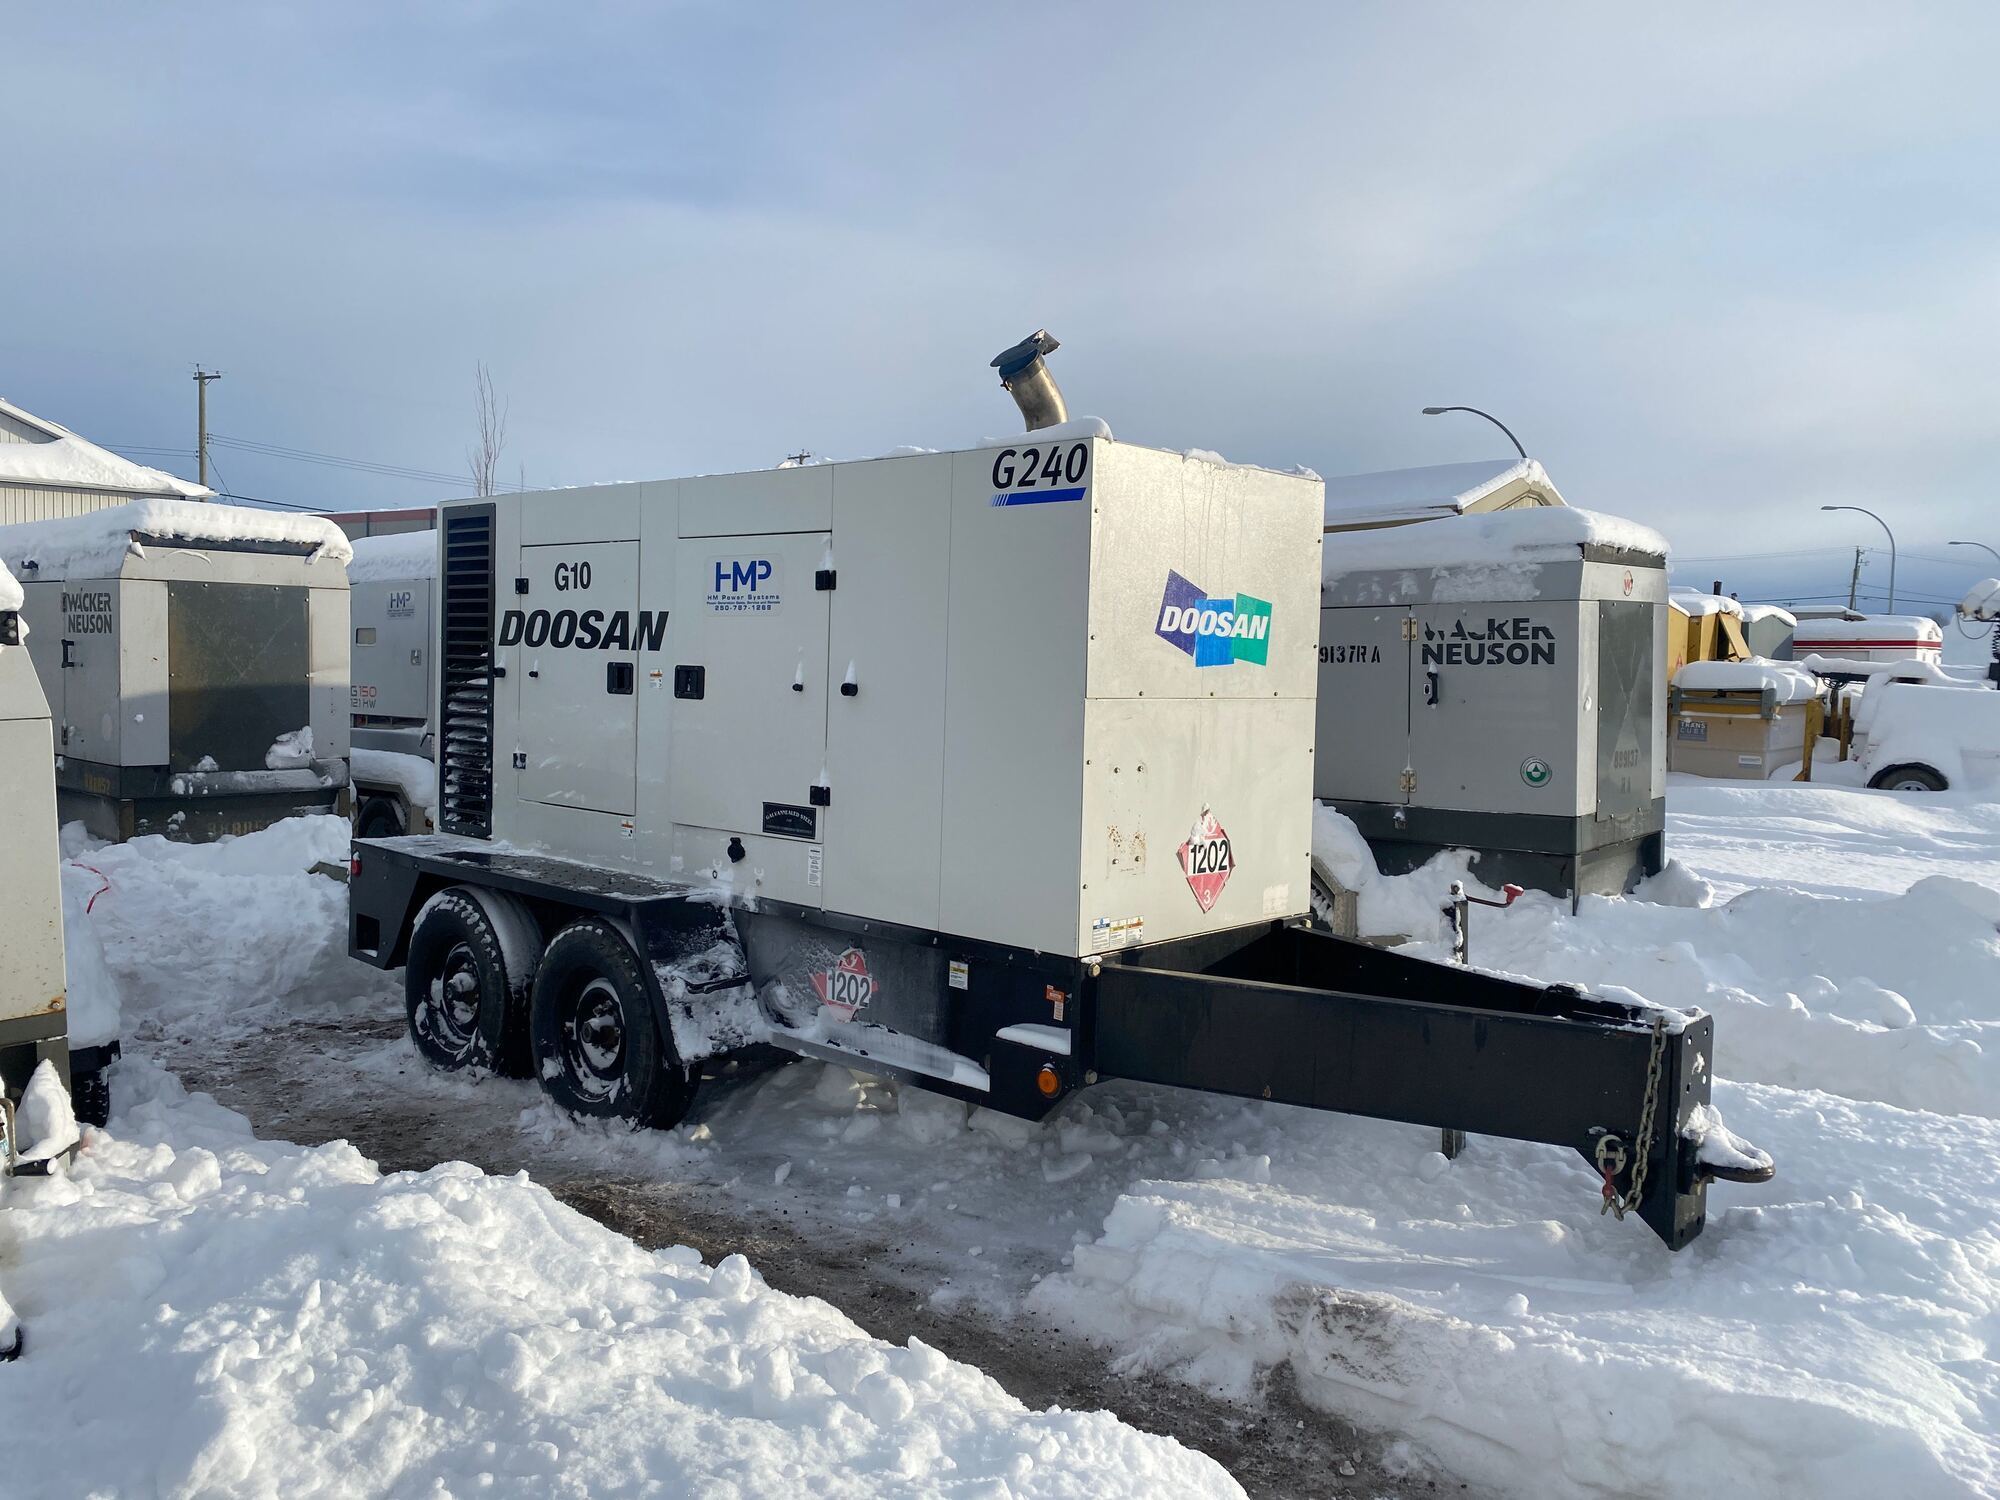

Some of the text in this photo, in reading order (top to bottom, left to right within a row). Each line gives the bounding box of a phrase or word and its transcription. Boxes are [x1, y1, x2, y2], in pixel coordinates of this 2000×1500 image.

[992, 443, 1088, 490] G240
[554, 561, 592, 591] G10
[715, 560, 772, 592] HMP
[66, 592, 112, 612] WACKER
[747, 593, 780, 601] Systems
[68, 614, 112, 634] NEUSON
[498, 609, 670, 652] DOOSAN
[1160, 605, 1269, 640] DOOSAN
[1421, 642, 1556, 665] NEUSON
[1681, 721, 1706, 729] TRANS
[1190, 840, 1228, 874] 1202
[1203, 889, 1211, 904] 3
[828, 970, 870, 1007] 1202
